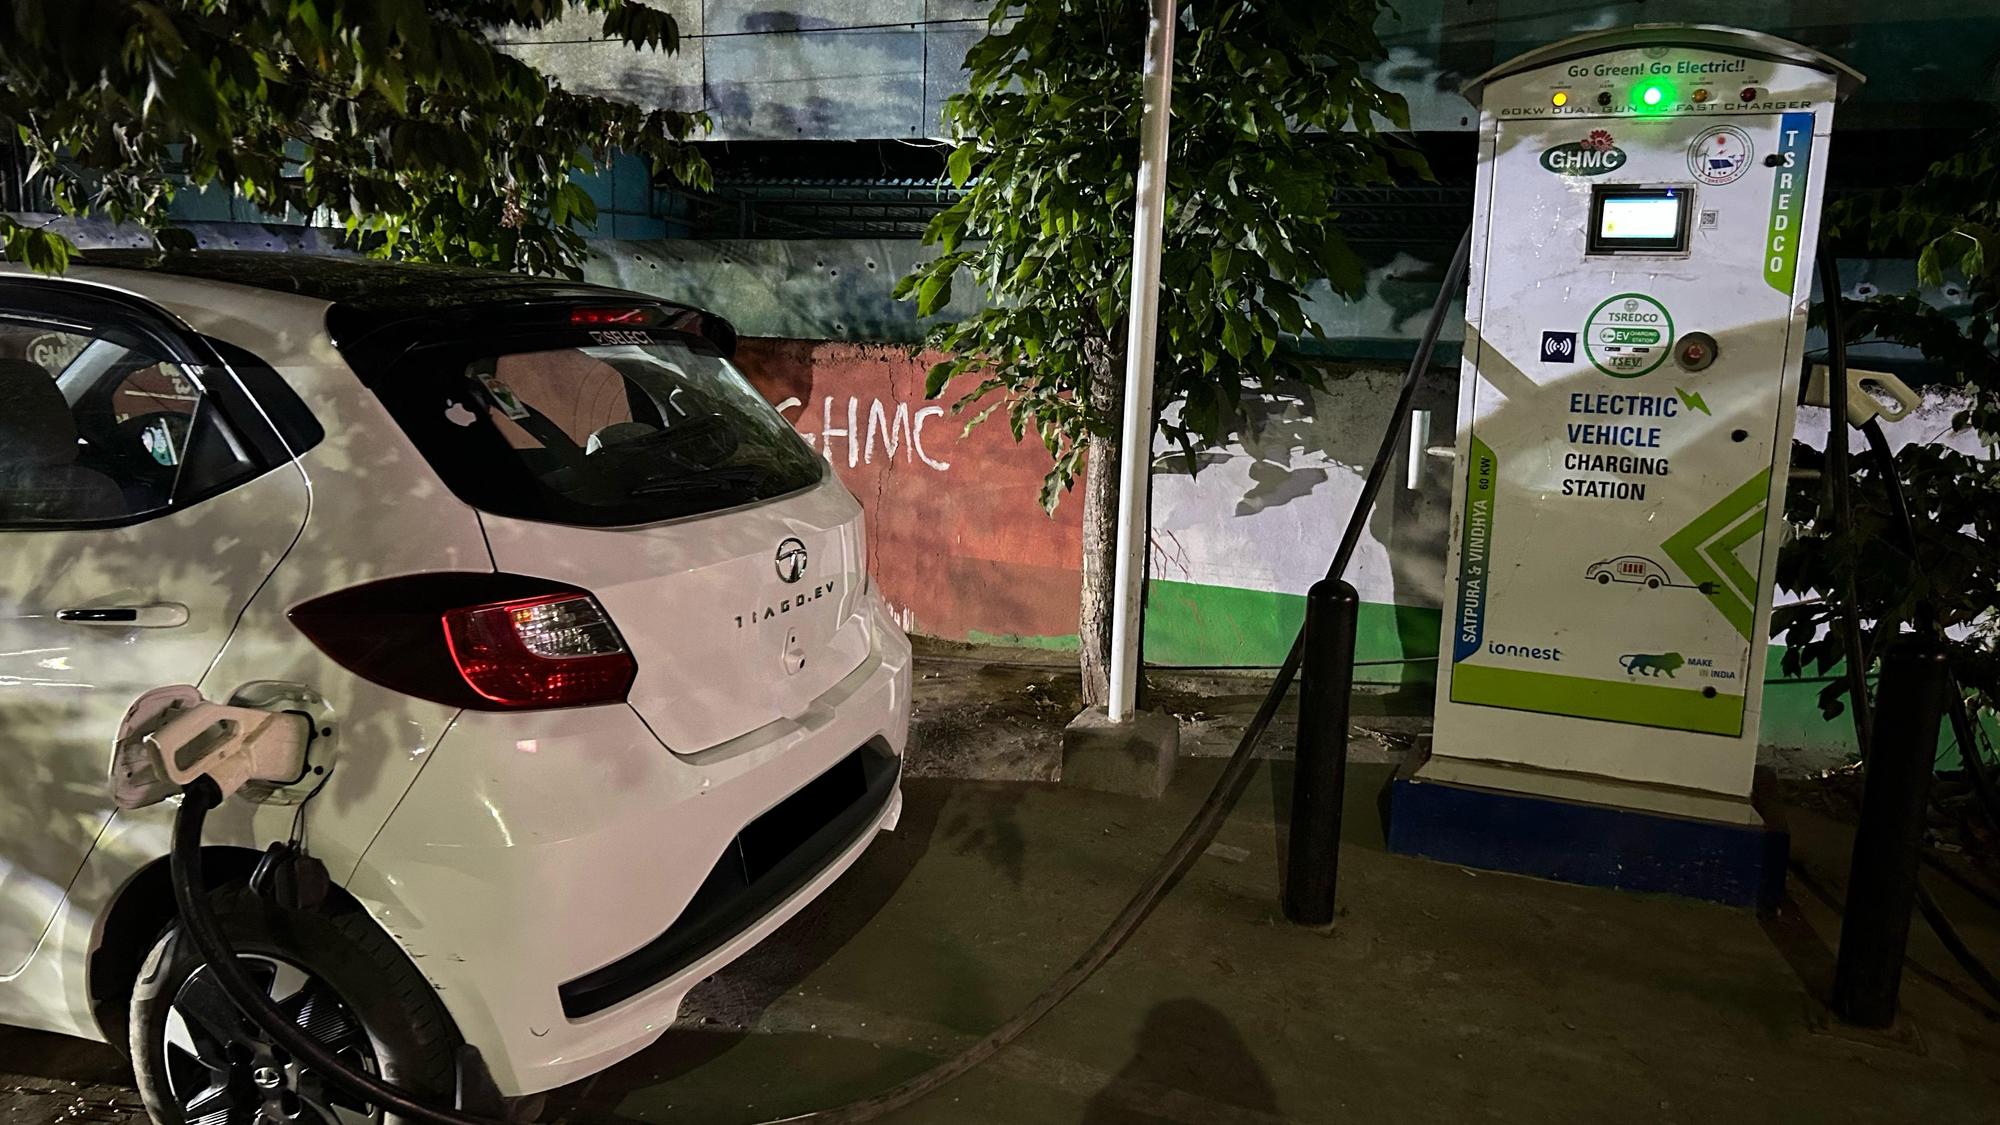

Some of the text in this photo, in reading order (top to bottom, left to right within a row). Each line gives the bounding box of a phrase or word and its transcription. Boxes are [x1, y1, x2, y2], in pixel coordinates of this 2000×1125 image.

[1568, 59, 1746, 77] Go Green! Go Electric!!
[1501, 107, 1545, 116] 60KW
[1552, 106, 1594, 115] DUAL
[1602, 105, 1638, 114] GUN
[1676, 103, 1717, 112] FAST
[1724, 100, 1812, 111] CHARGER
[1548, 150, 1618, 169] GHMC
[1608, 312, 1659, 323] TSREDCO
[602, 330, 656, 345] SELECT
[1616, 331, 1630, 341] EV
[1611, 356, 1640, 367] TSEV
[1569, 393, 1678, 417] ELECTRIC
[1567, 423, 1661, 448] VEHICLE
[1564, 453, 1669, 476] CHARGING
[1561, 479, 1646, 501] STATION
[1462, 457, 1491, 643] SATPURA & VINDHYA 60 KW
[1489, 640, 1562, 661] ionnest
[1687, 658, 1713, 667] MAKE
[1699, 669, 1736, 679] IN INDIA
